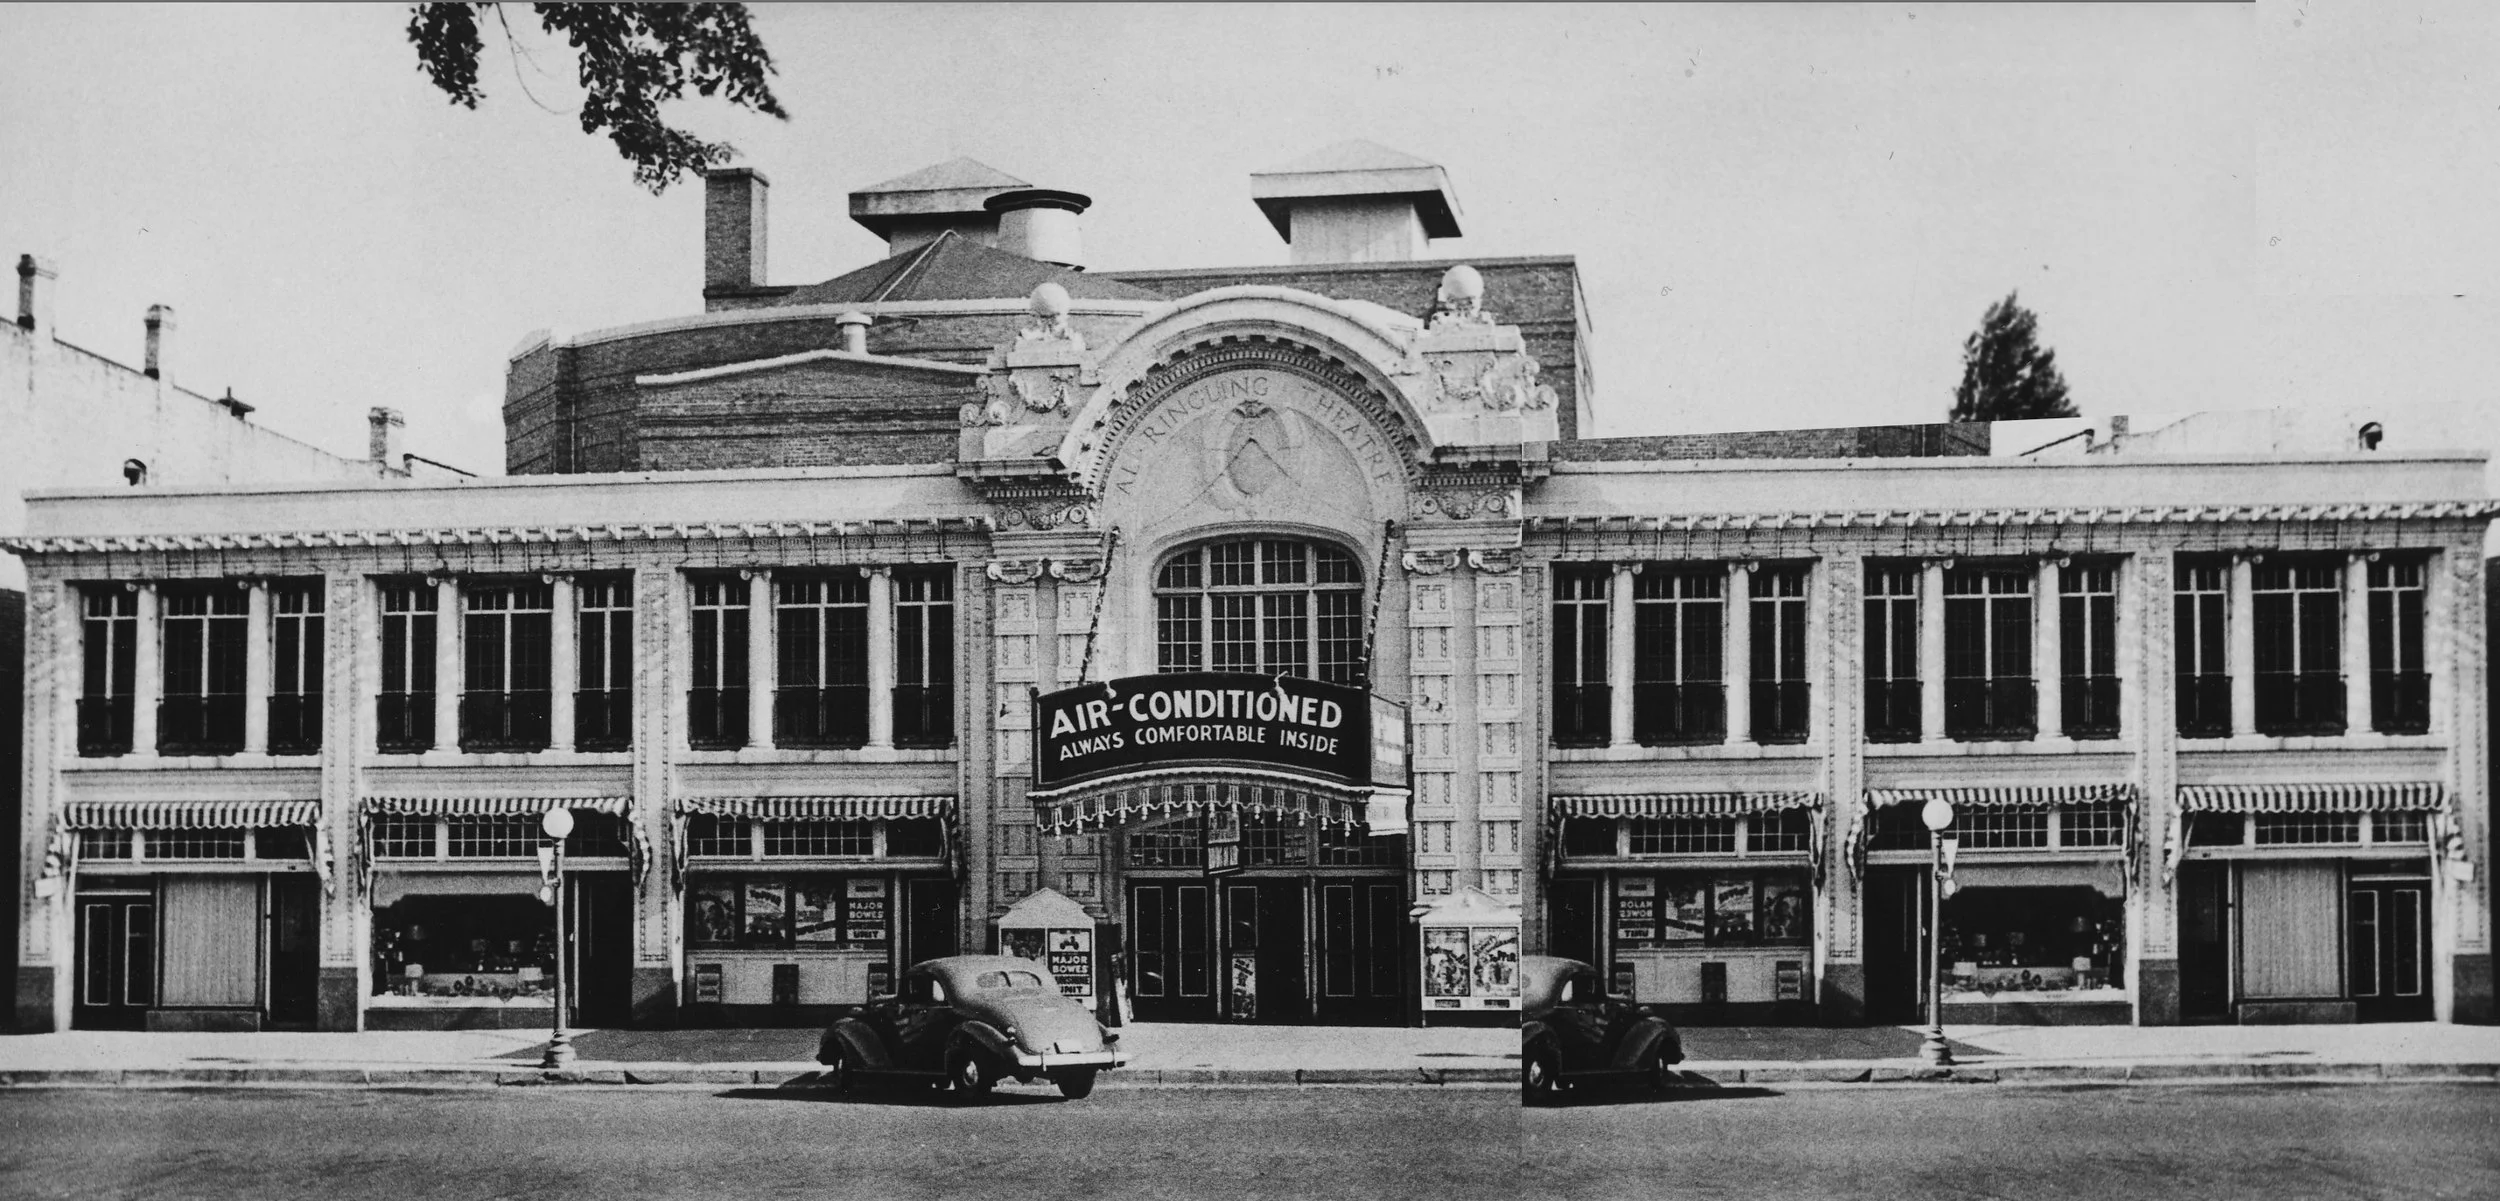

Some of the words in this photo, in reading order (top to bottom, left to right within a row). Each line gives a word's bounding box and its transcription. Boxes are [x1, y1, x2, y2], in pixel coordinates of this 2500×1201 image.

[1142, 376, 1269, 444] RINGLING
[1301, 383, 1396, 489] THEATRE
[1050, 689, 1342, 739] AIR-CONDITIONED
[1060, 731, 1125, 761] ALWAYS
[1135, 724, 1266, 745] COMFORTABLE
[1280, 729, 1339, 755] INSIDE
[1052, 955, 1088, 964] MAJOR
[1052, 965, 1089, 974] BOWES
